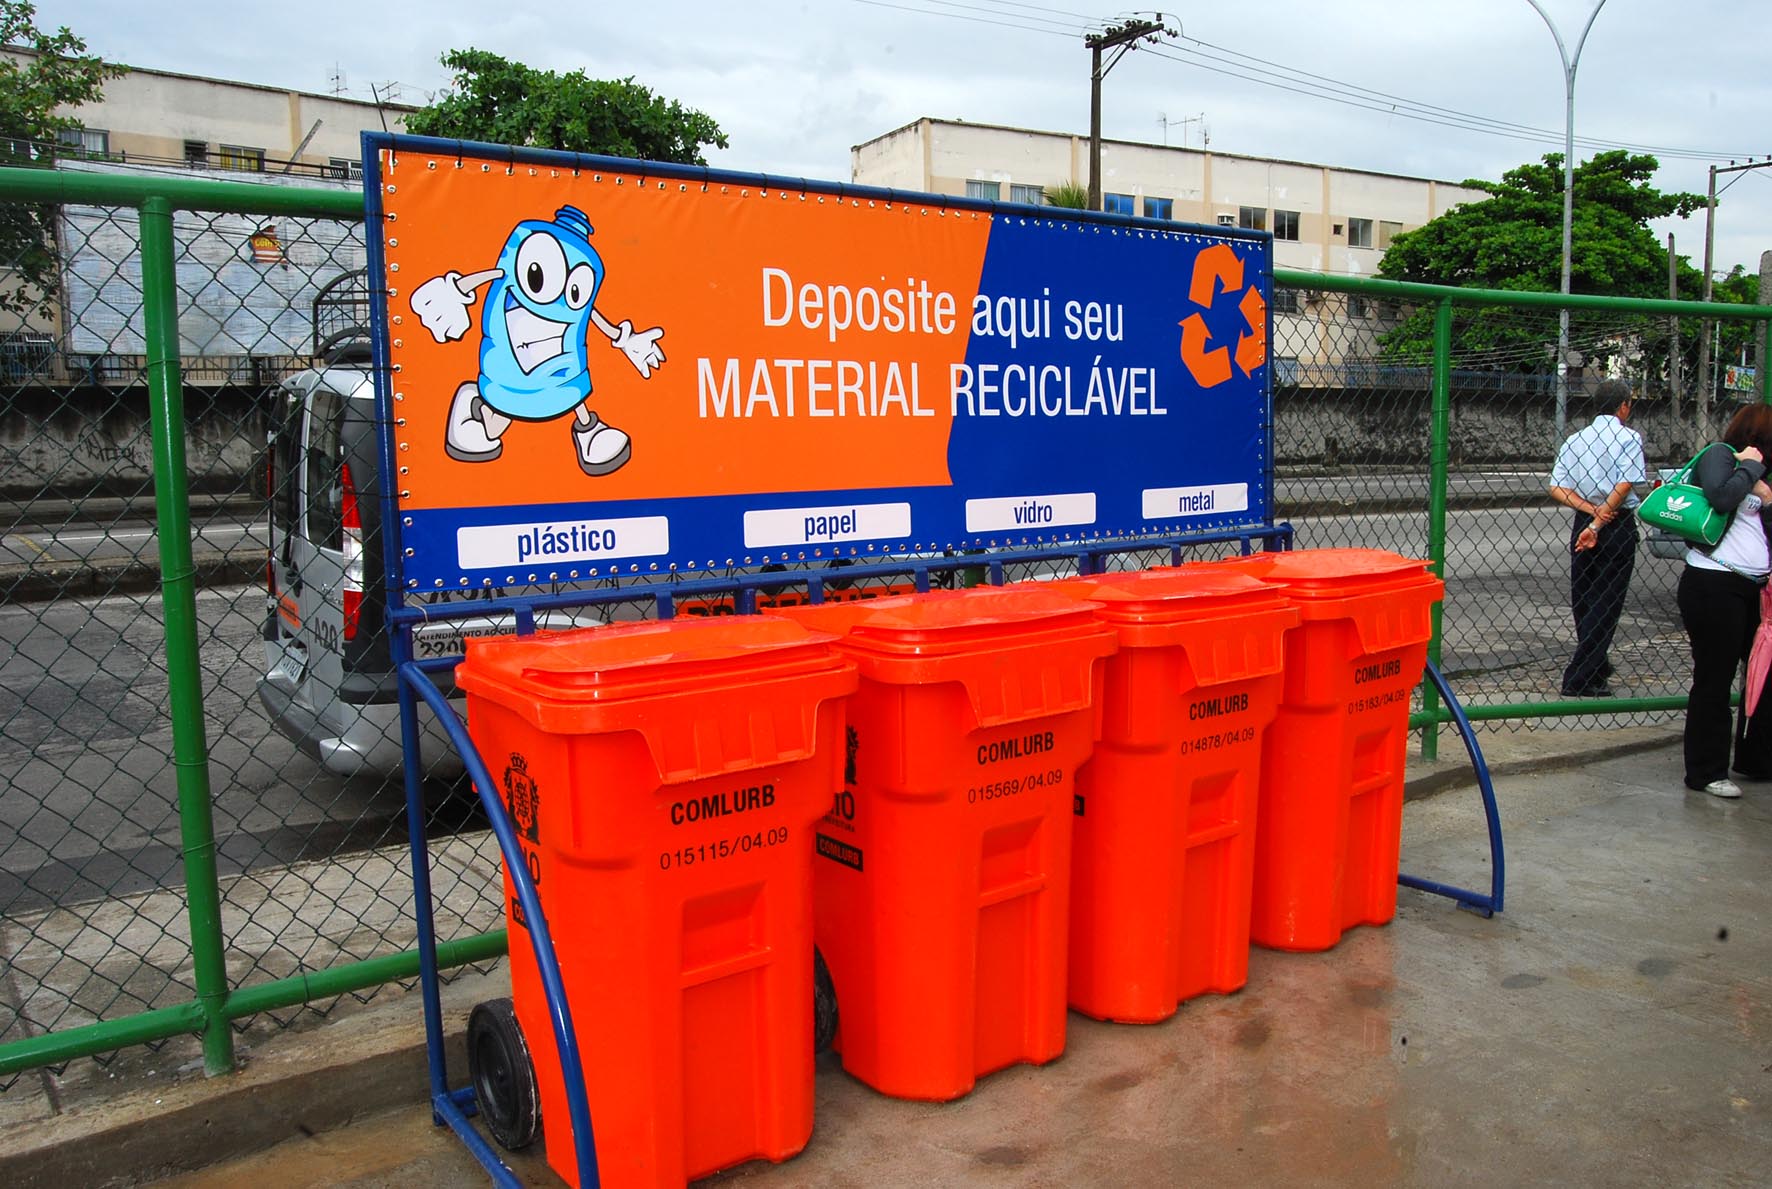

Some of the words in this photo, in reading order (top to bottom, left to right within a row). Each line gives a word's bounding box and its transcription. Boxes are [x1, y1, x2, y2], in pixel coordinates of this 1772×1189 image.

[762, 267, 956, 342] Deposite
[971, 287, 1050, 349] aqui
[1064, 300, 1124, 342] seu
[697, 357, 935, 418] MATERIAL
[950, 355, 1168, 417] RECICLÁVEL
[1013, 500, 1053, 525] vidro
[1178, 489, 1215, 514] metal
[1659, 511, 1683, 521] adidas
[804, 509, 857, 542] papel
[517, 524, 616, 563] plástico
[1355, 659, 1401, 685] COMLURB
[1188, 693, 1249, 721] COMLURB
[976, 731, 1055, 766] COMLURB
[1181, 727, 1255, 755] 014878/04.09
[967, 769, 1063, 804] 015569/04.09
[671, 783, 776, 826] COMLURB
[831, 790, 856, 821] IO
[659, 826, 789, 870] 015115/04.09
